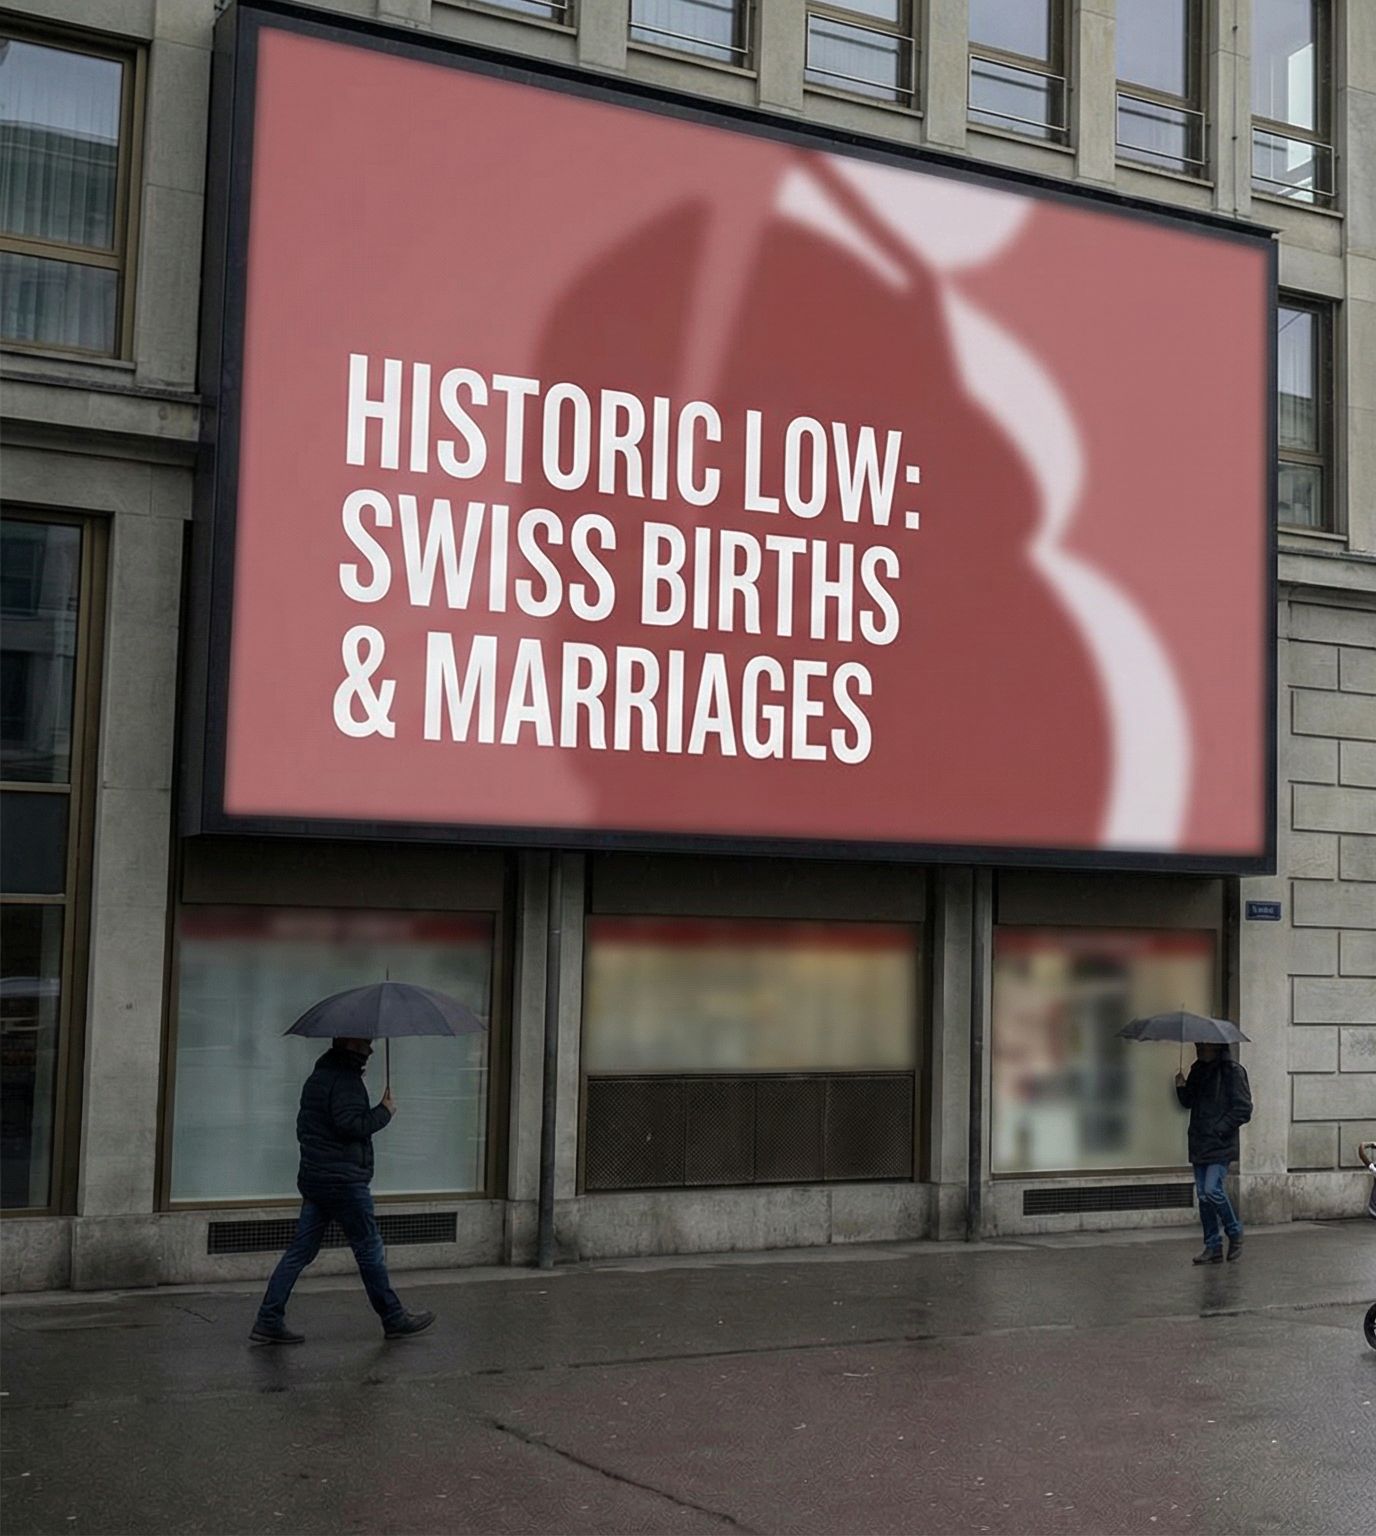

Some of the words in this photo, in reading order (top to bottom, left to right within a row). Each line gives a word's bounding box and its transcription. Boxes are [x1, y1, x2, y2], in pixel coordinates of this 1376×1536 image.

[346, 353, 722, 506] HISTORIC
[744, 409, 921, 530] LOW:
[339, 488, 617, 622] SWISS
[641, 521, 900, 646] BIRTHS
[332, 624, 397, 739] &
[423, 631, 873, 764] MARRIAGES
